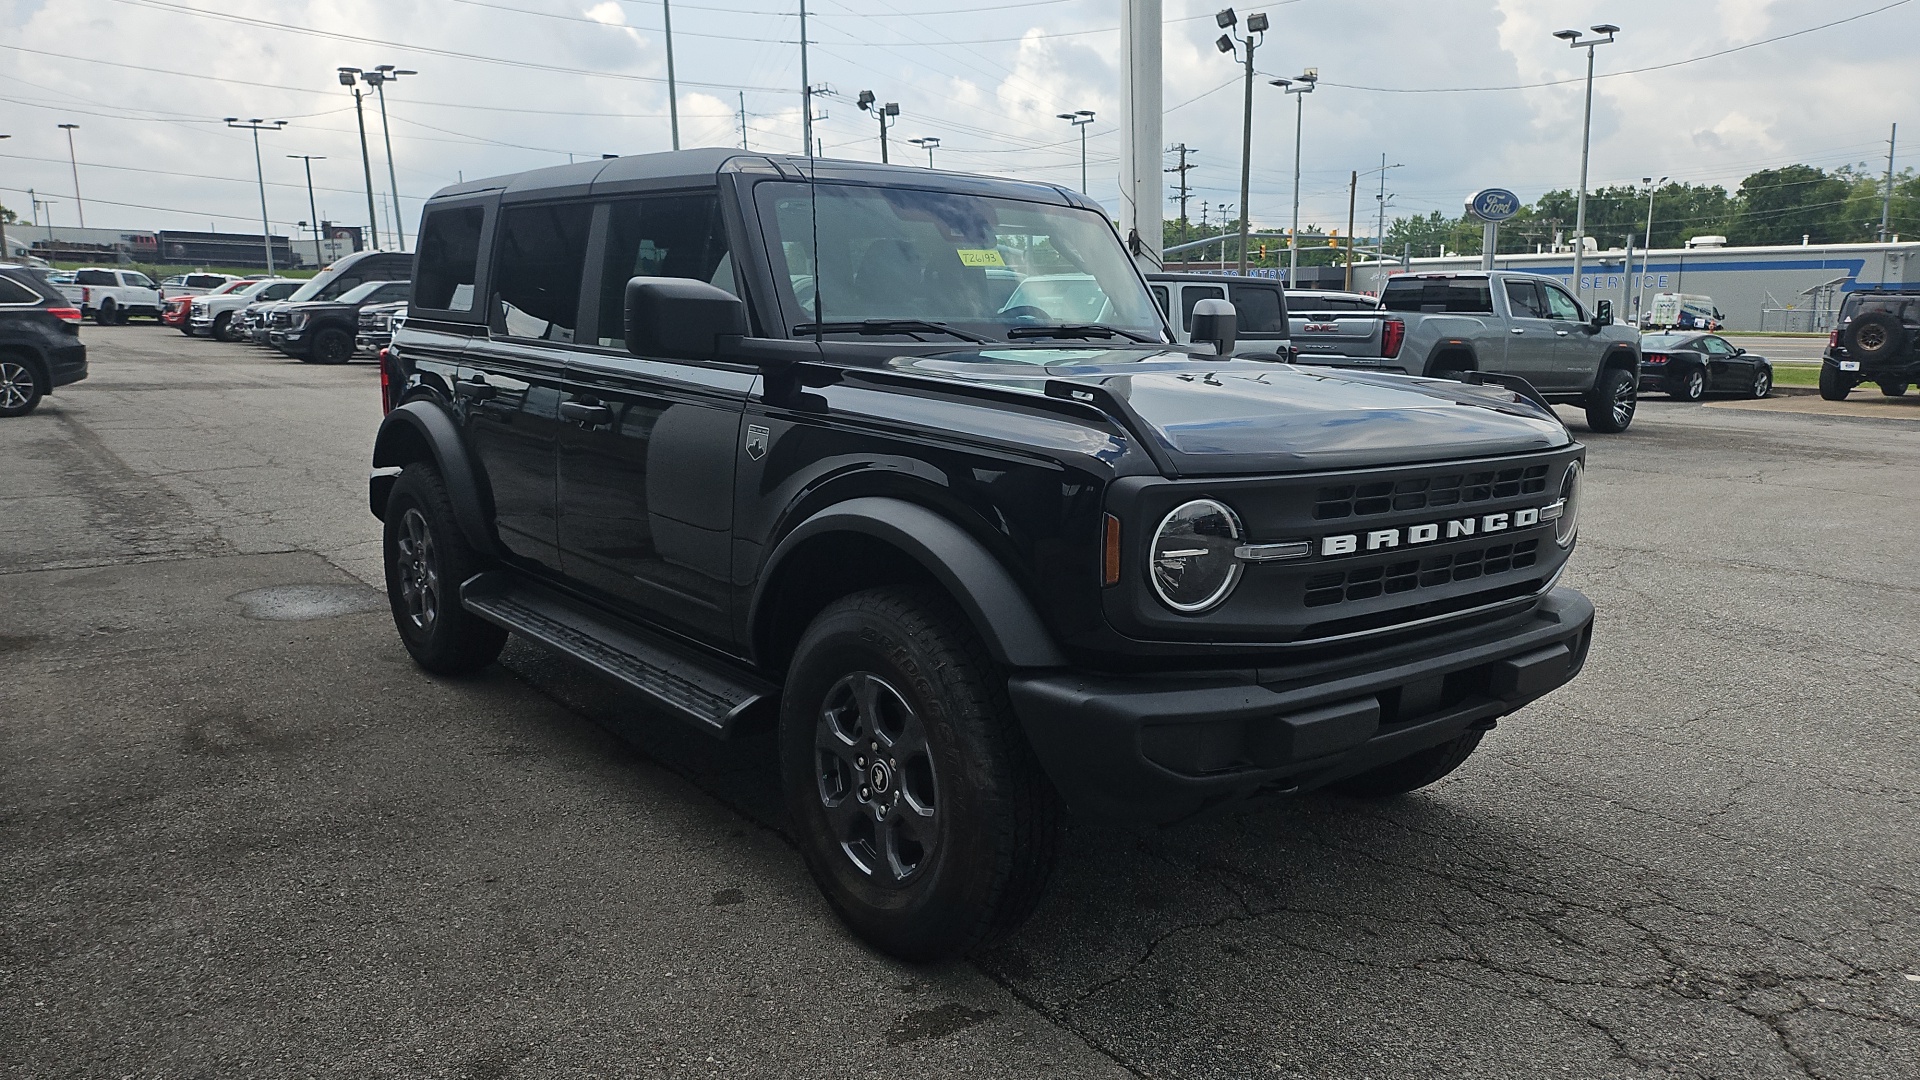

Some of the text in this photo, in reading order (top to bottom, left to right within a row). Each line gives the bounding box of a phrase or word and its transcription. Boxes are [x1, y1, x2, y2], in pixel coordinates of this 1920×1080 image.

[1483, 193, 1512, 214] Ford
[962, 253, 997, 263] T26193
[1222, 269, 1288, 280] NTRY
[1304, 323, 1339, 332] GMC
[1321, 508, 1539, 556] BRONCO
